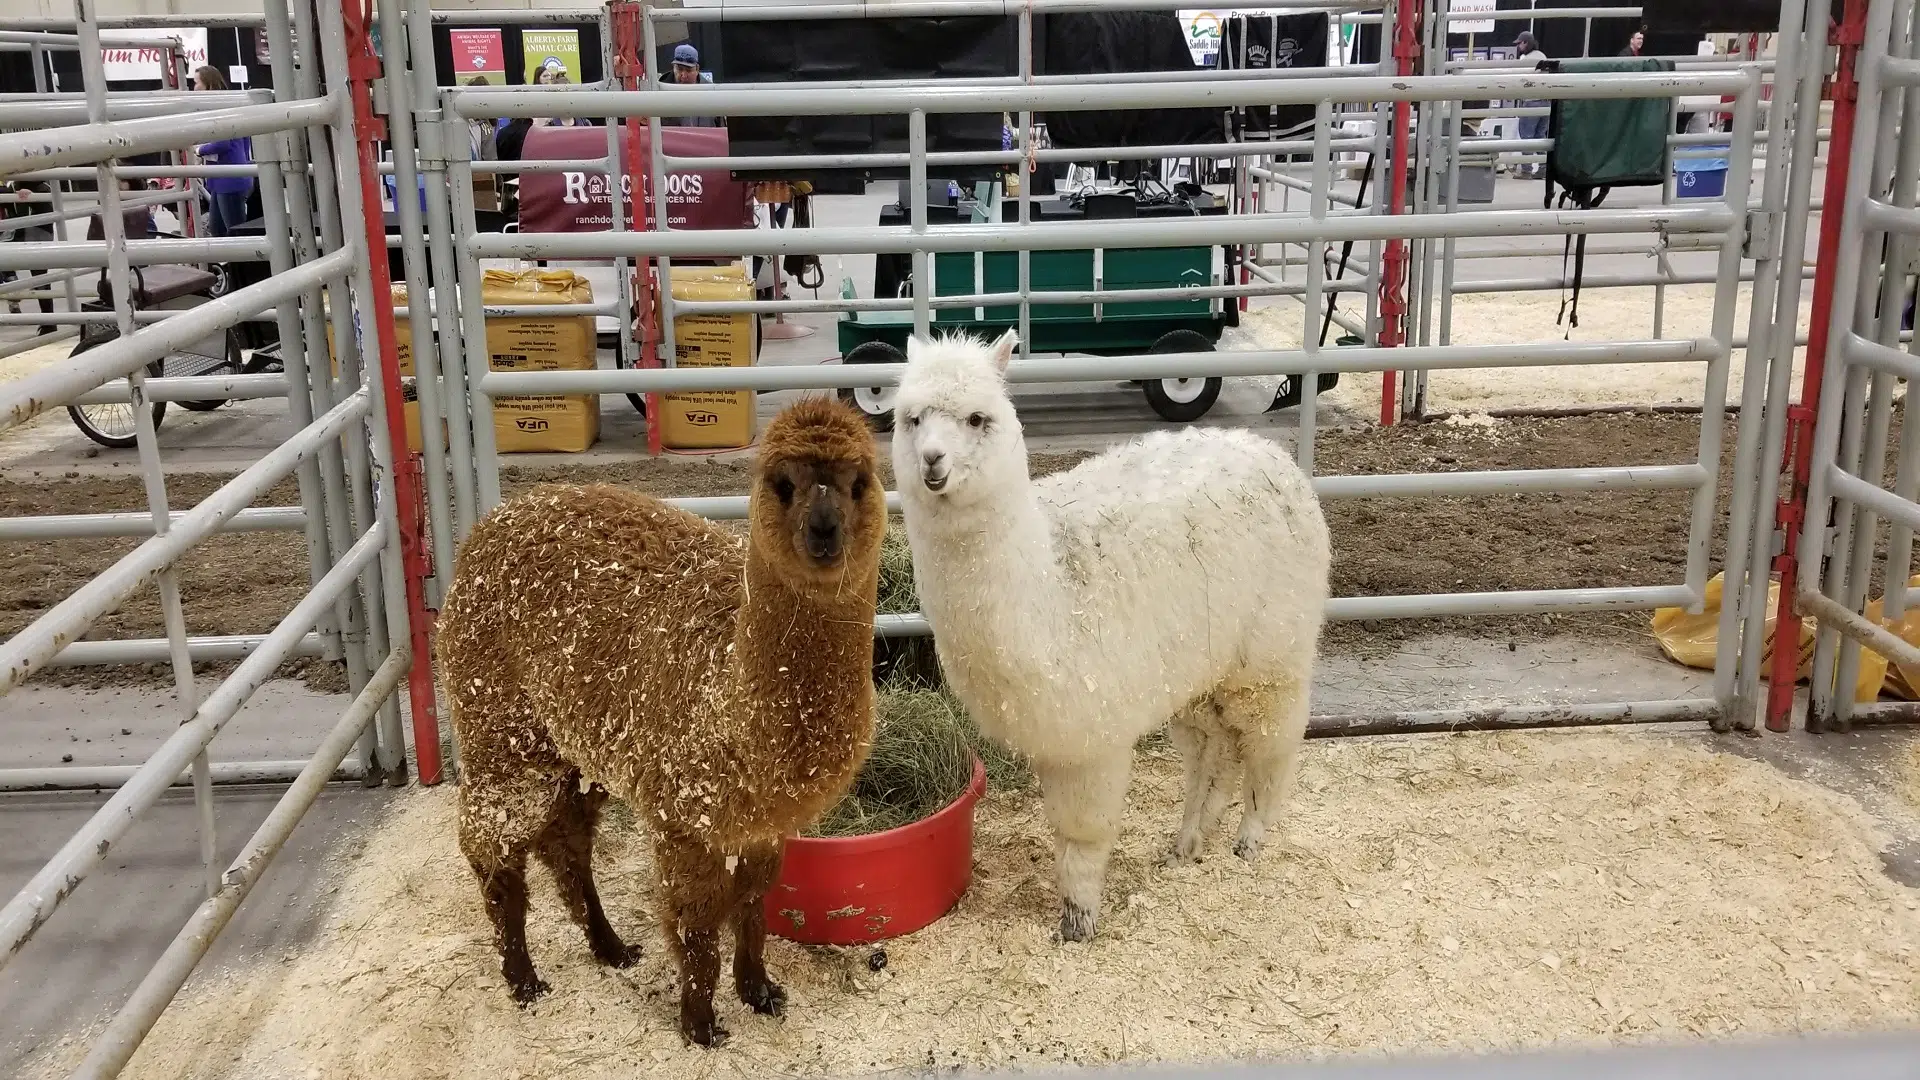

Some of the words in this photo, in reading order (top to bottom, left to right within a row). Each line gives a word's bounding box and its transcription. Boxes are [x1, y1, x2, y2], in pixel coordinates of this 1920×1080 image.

[1452, 5, 1472, 13] HAND
[526, 35, 557, 43] ALBERTA
[557, 35, 577, 43] FARM
[526, 44, 556, 52] ANIMAL
[556, 44, 577, 52] CARE
[1190, 39, 1209, 49] Saddle
[1210, 39, 1220, 49] Hill
[685, 413, 718, 423] UFA
[515, 420, 549, 429] UFA
